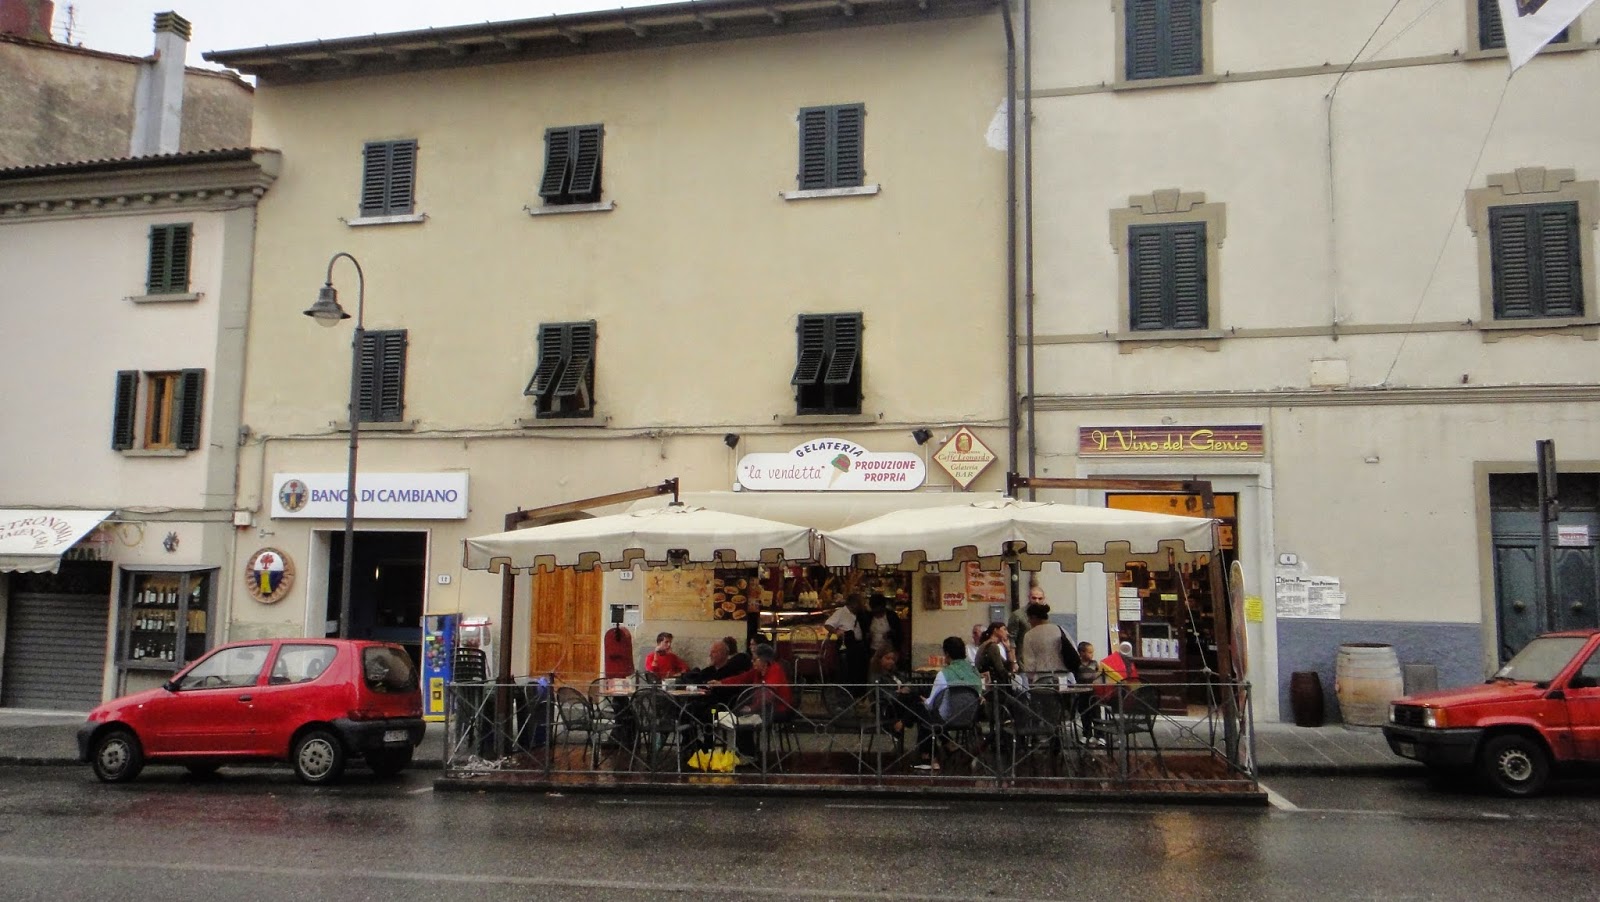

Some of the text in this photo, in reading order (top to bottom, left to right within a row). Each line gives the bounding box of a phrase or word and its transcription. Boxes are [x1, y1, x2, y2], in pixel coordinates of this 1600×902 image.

[1112, 429, 1158, 451] Vino
[1163, 434, 1183, 451] del
[1190, 429, 1249, 451] Genio
[796, 442, 864, 458] GELATERIA
[958, 452, 990, 461] Leonardo
[855, 460, 916, 470] PRODUZIONE
[864, 472, 907, 482] PROPRIA
[362, 489, 375, 502] DI
[378, 489, 458, 502] CAMBIANO
